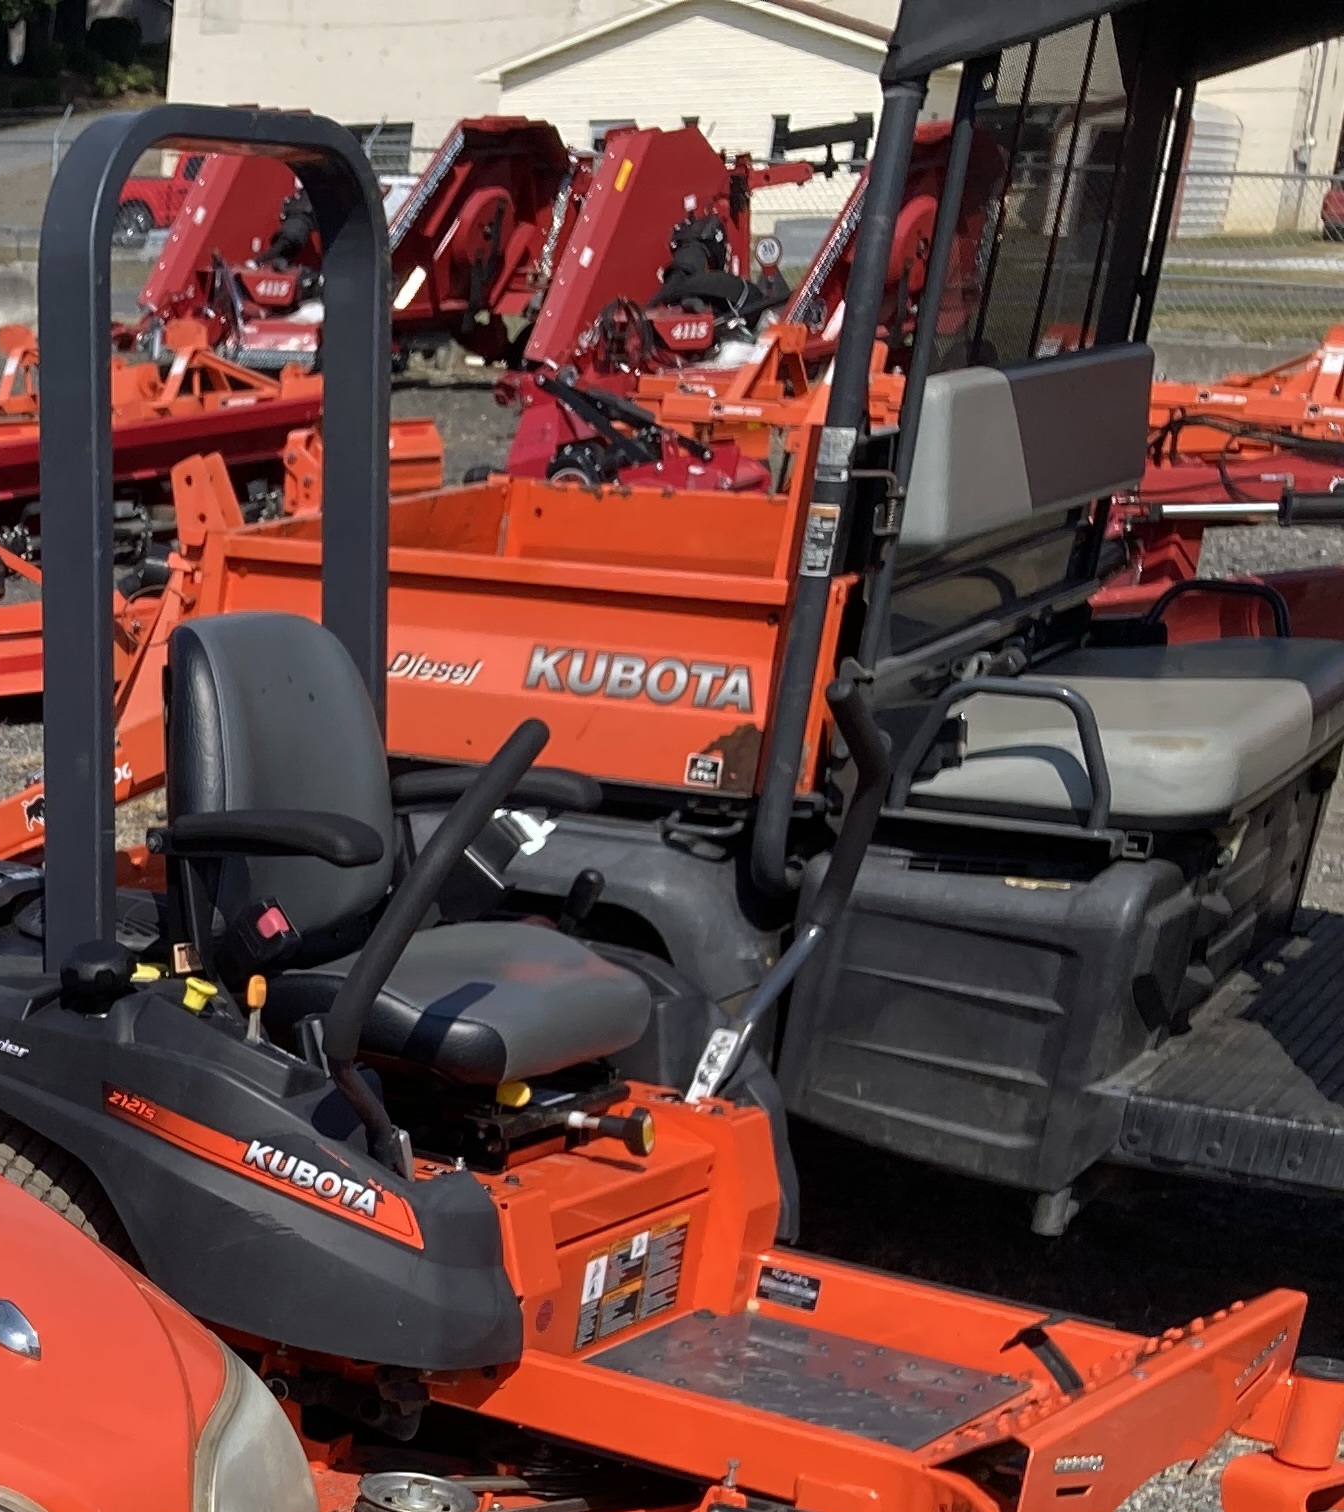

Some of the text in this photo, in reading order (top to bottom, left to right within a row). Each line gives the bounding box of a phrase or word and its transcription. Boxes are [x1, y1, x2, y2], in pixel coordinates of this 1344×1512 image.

[386, 651, 484, 687] Diesel
[522, 644, 755, 714] KUBOTA
[242, 1139, 380, 1218] KUBOTA
